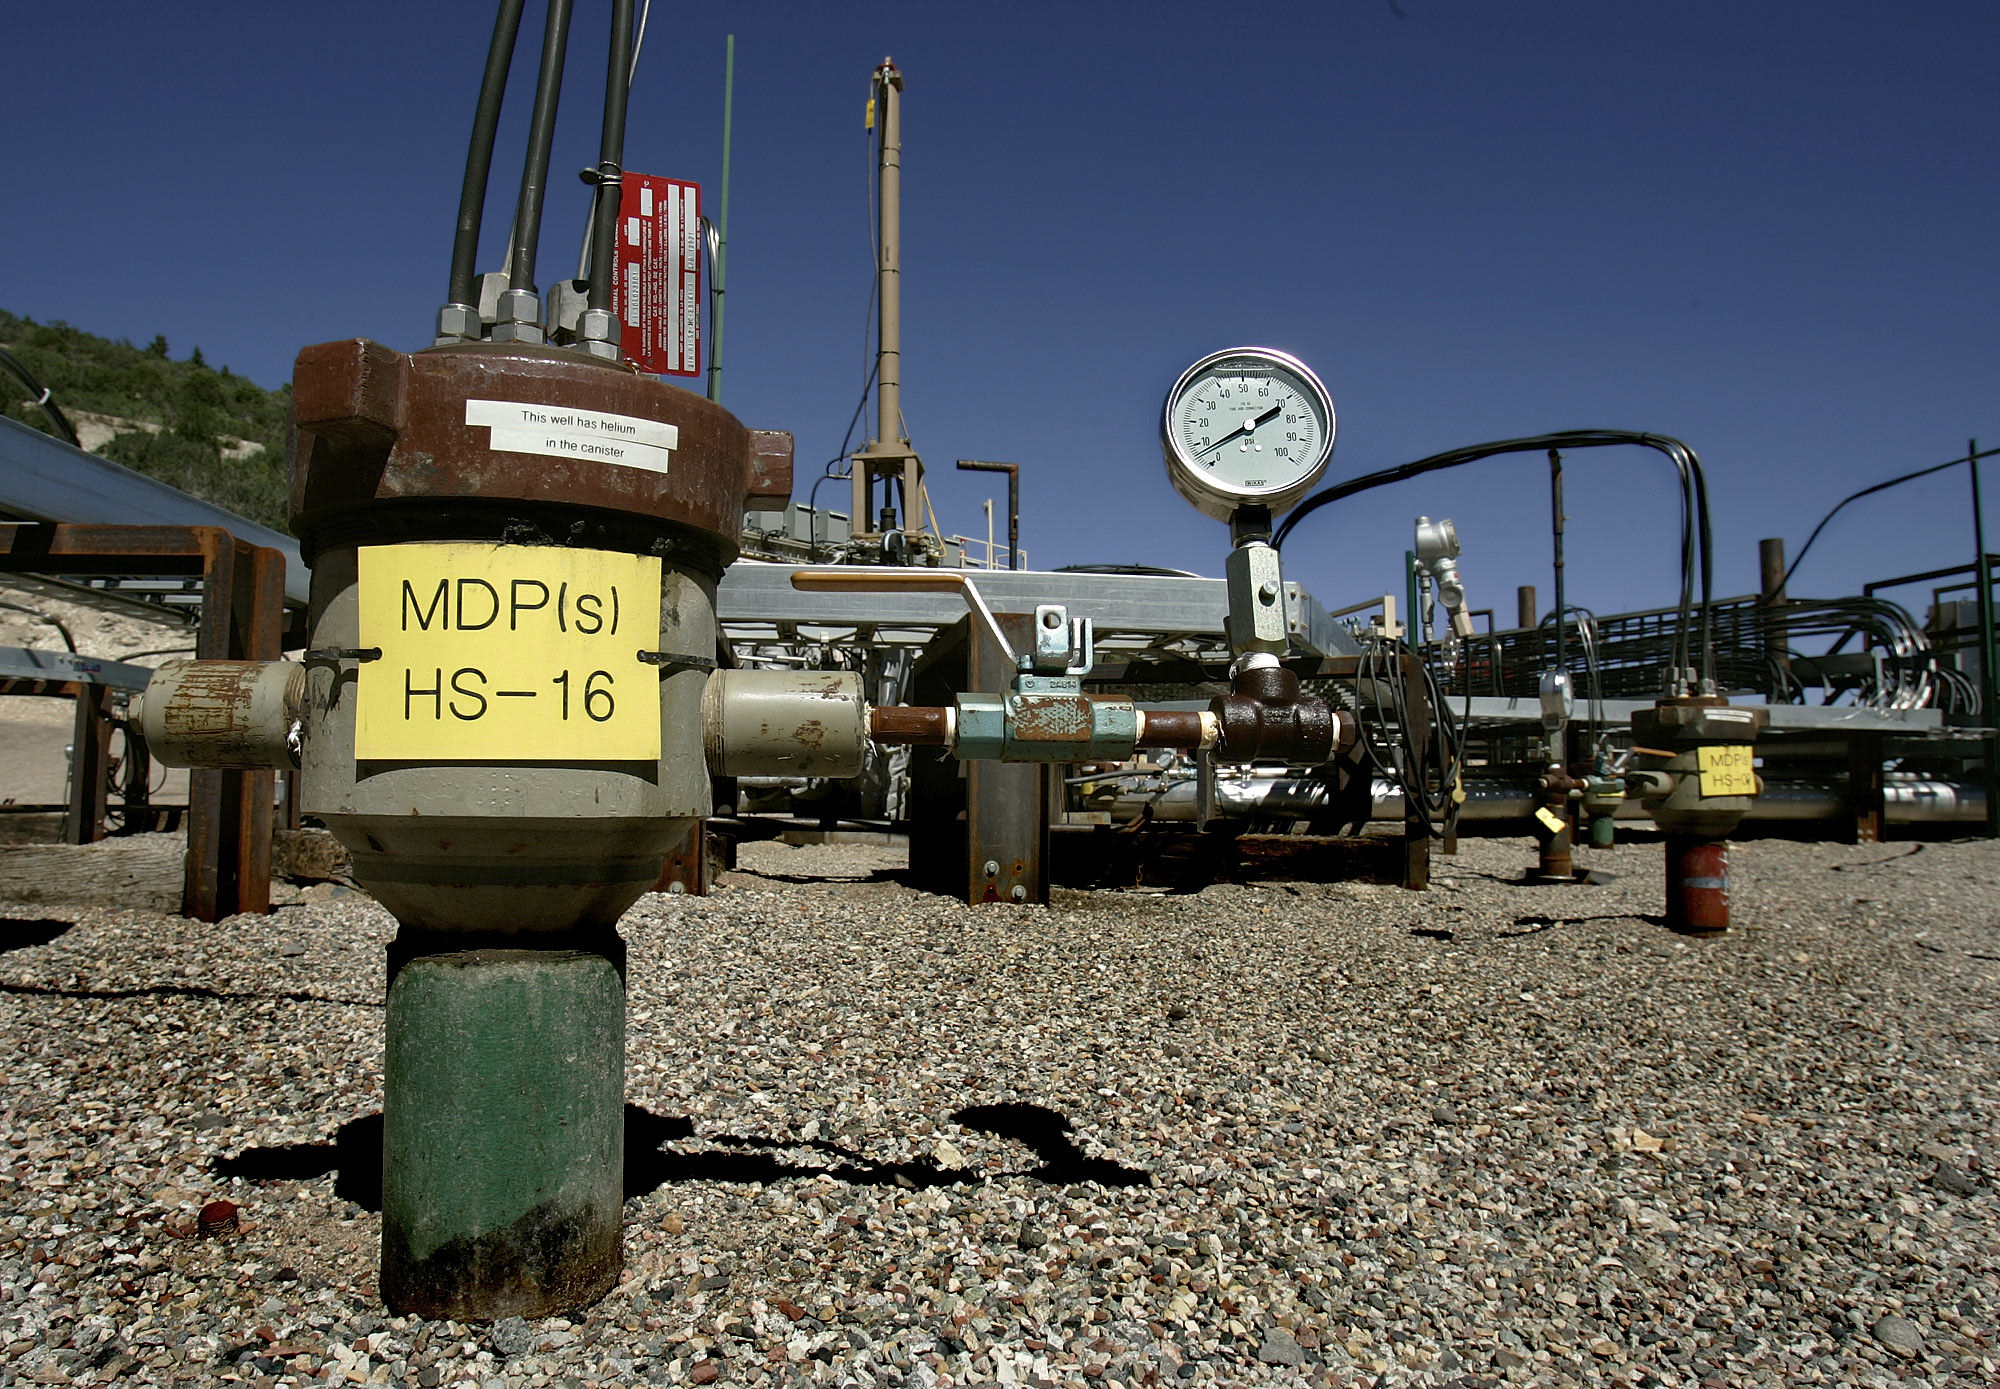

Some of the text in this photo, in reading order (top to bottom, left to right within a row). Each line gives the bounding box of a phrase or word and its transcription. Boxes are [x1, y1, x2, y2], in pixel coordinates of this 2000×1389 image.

[1238, 383, 1249, 393] 50
[1258, 387, 1269, 397] 60
[1219, 388, 1231, 399] 40
[1206, 401, 1216, 411] 30
[1275, 399, 1286, 409] 70
[520, 410, 636, 435] This well has helium
[1199, 417, 1209, 428] 20
[1286, 414, 1297, 424] 80
[1201, 436, 1210, 447] 10
[1244, 436, 1255, 446] psi
[1286, 432, 1297, 442] 90
[546, 437, 625, 458] in the canister
[1274, 447, 1289, 457] 100
[1215, 452, 1221, 462] 0
[401, 578, 620, 636] MDP(s)
[404, 667, 616, 723] HS-16
